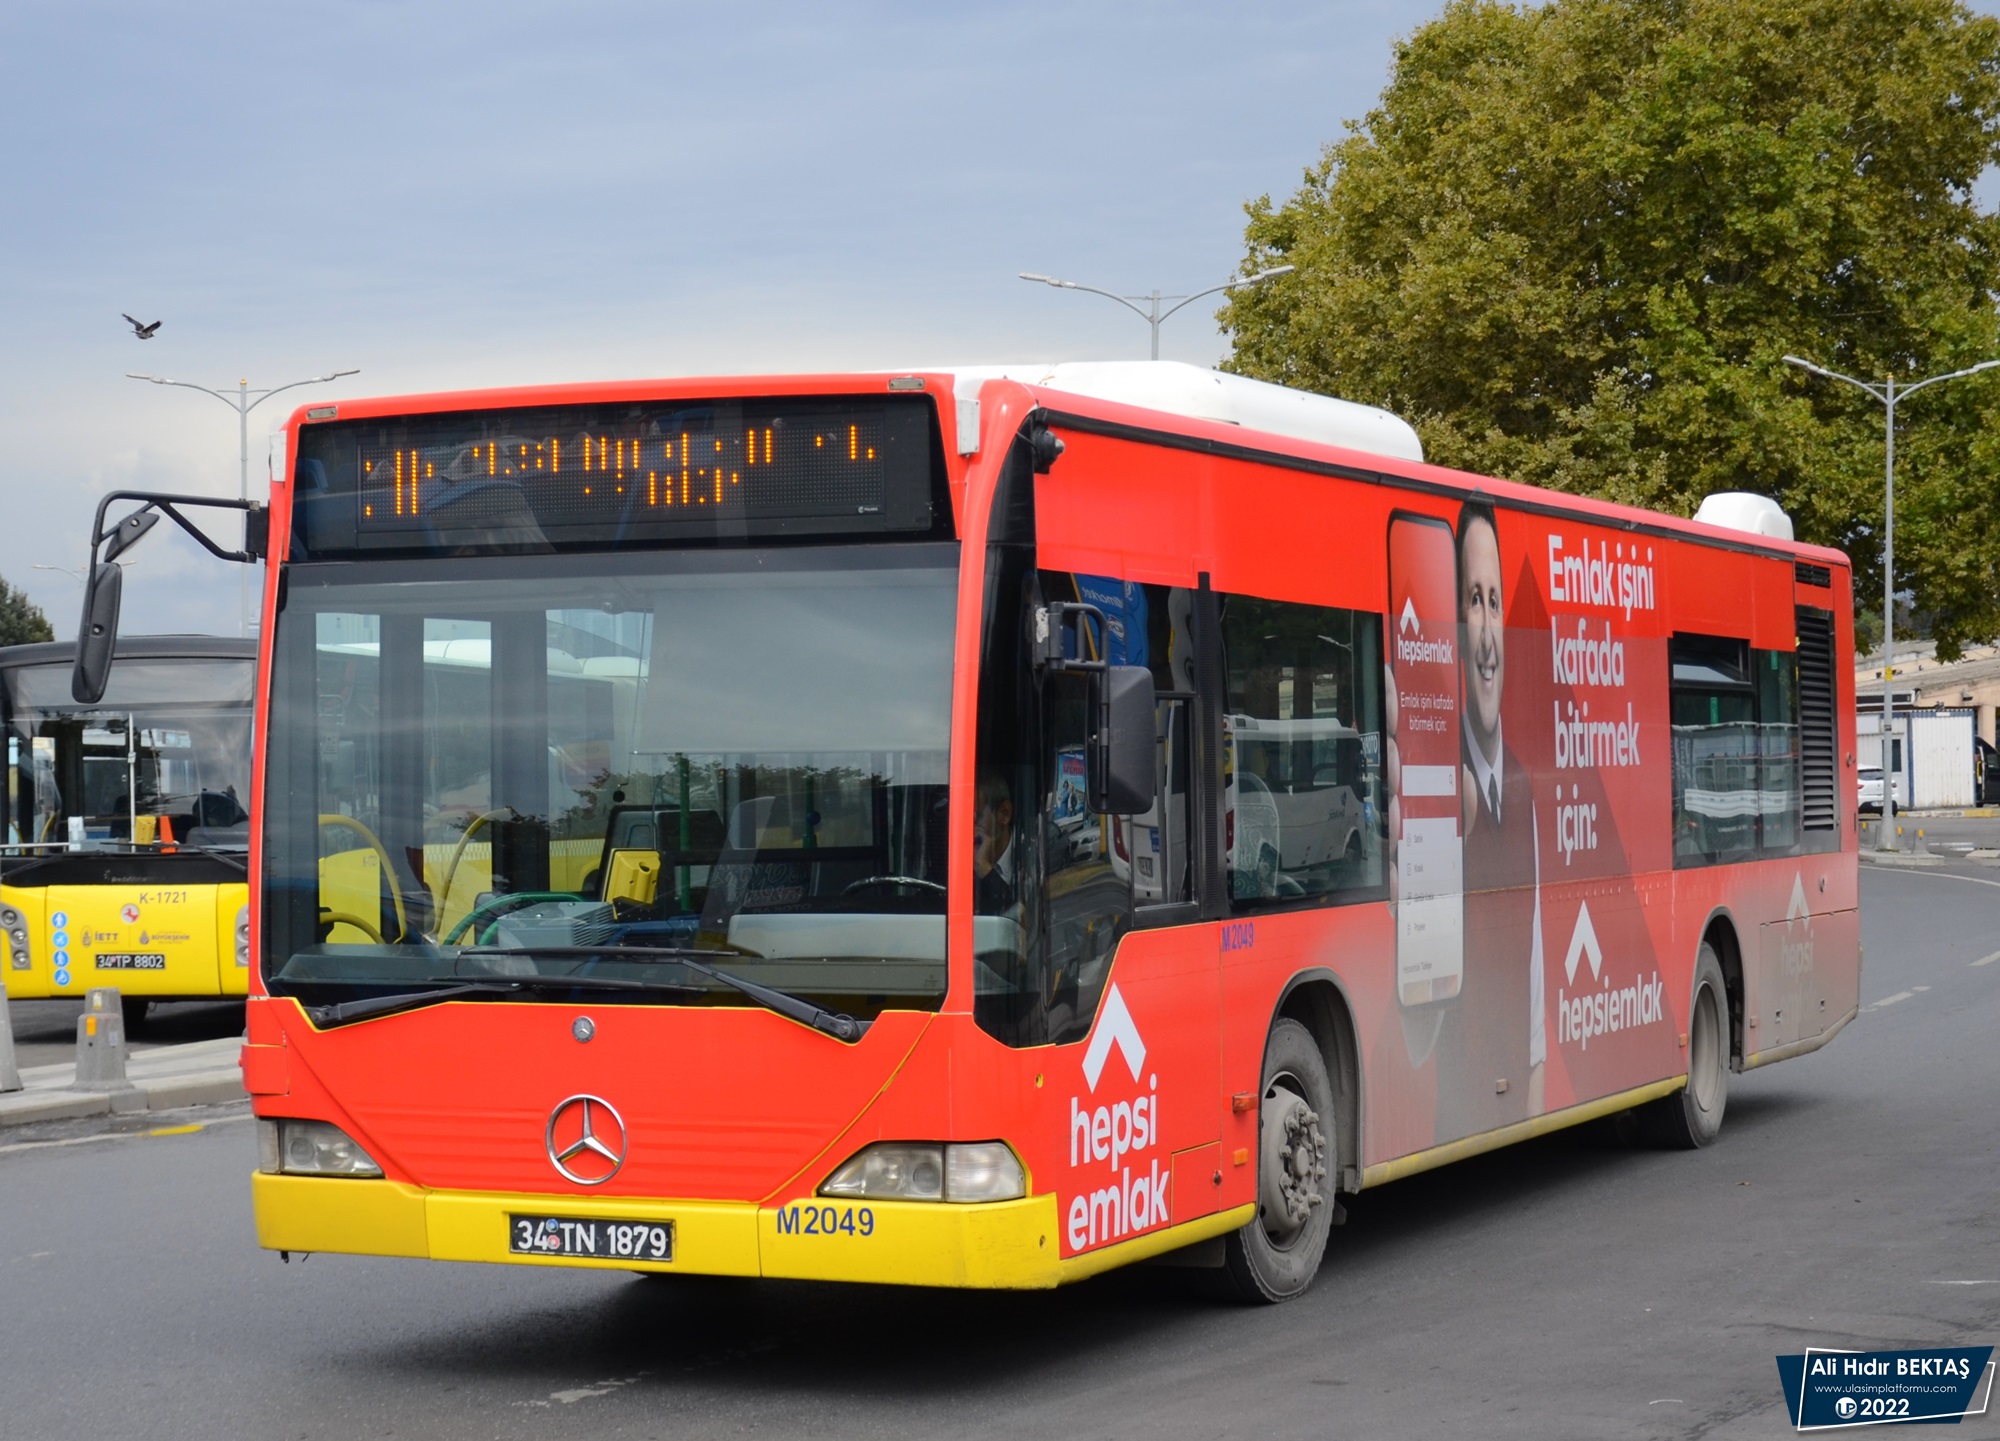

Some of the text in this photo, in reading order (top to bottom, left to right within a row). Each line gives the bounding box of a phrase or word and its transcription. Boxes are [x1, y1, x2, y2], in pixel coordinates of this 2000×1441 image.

[1548, 534, 1655, 622] Emlak işini
[1397, 634, 1454, 667] hepsiemlak
[1551, 616, 1625, 686] kafada
[1400, 692, 1454, 711] Emlak işini kafada
[1409, 715, 1434, 731] bitirmek
[1554, 700, 1641, 769] bitirmek
[1556, 784, 1598, 866] için:
[139, 891, 187, 904] K-1721
[94, 931, 119, 941] İETT
[1781, 928, 1814, 983] hepsi
[97, 955, 163, 968] 34 TP 8802
[1559, 971, 1663, 1051] hepsiemlak
[1070, 1073, 1157, 1172] hepsi
[776, 1206, 875, 1236] M2049
[1068, 1159, 1170, 1251] emlak
[517, 1220, 667, 1257] 34 TN 1879
